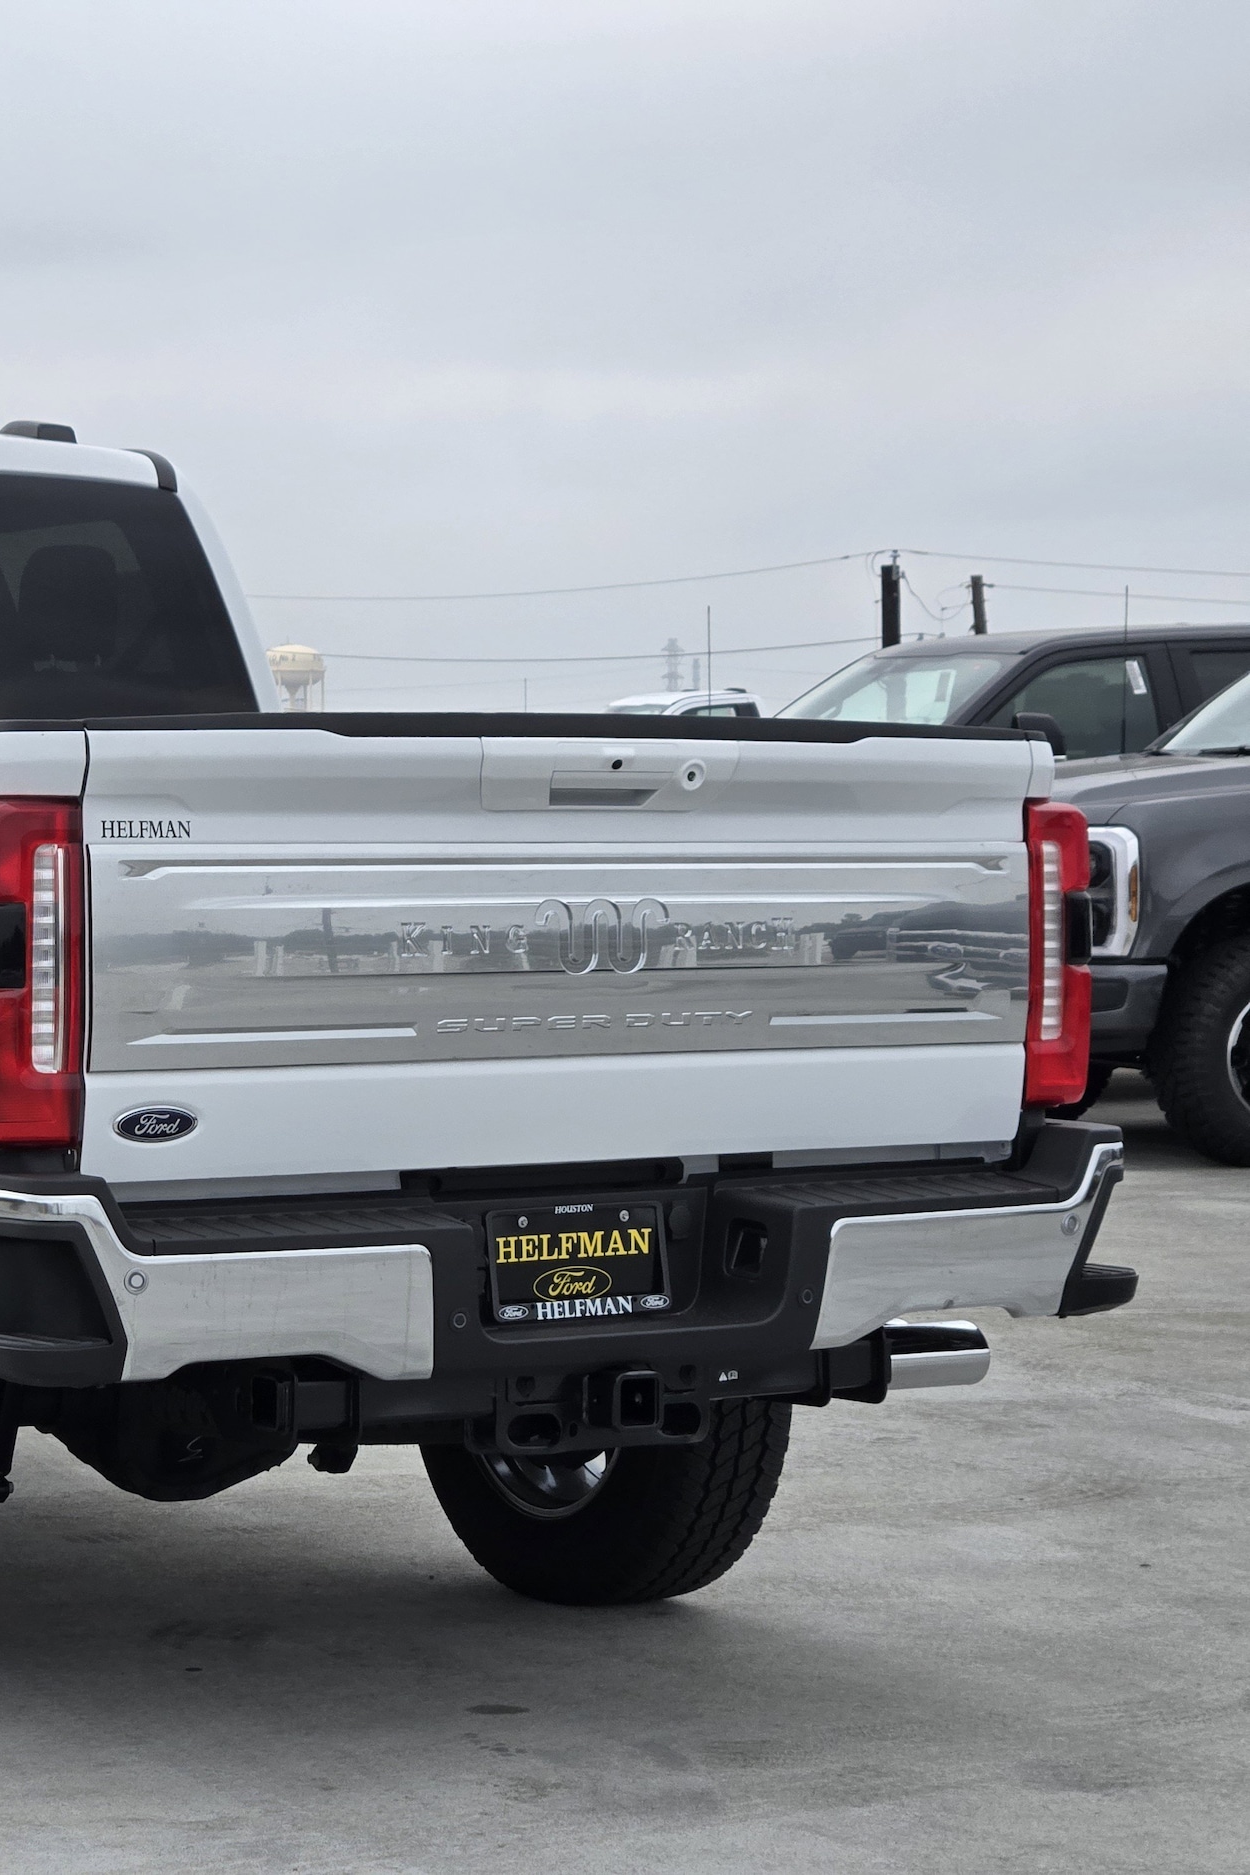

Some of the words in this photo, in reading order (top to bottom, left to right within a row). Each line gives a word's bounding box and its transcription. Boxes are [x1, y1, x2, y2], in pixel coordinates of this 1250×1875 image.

[101, 820, 191, 839] HELFMAN
[400, 921, 531, 957] KING
[673, 916, 795, 951] RANCH
[436, 1013, 612, 1034] SUPER
[625, 1010, 753, 1027] DUTY
[134, 1113, 181, 1135] Ford
[554, 1203, 594, 1214] HOUSTON
[495, 1227, 652, 1264] HELFMAN
[548, 1270, 597, 1296] Ford
[536, 1295, 633, 1320] HELFMAN
